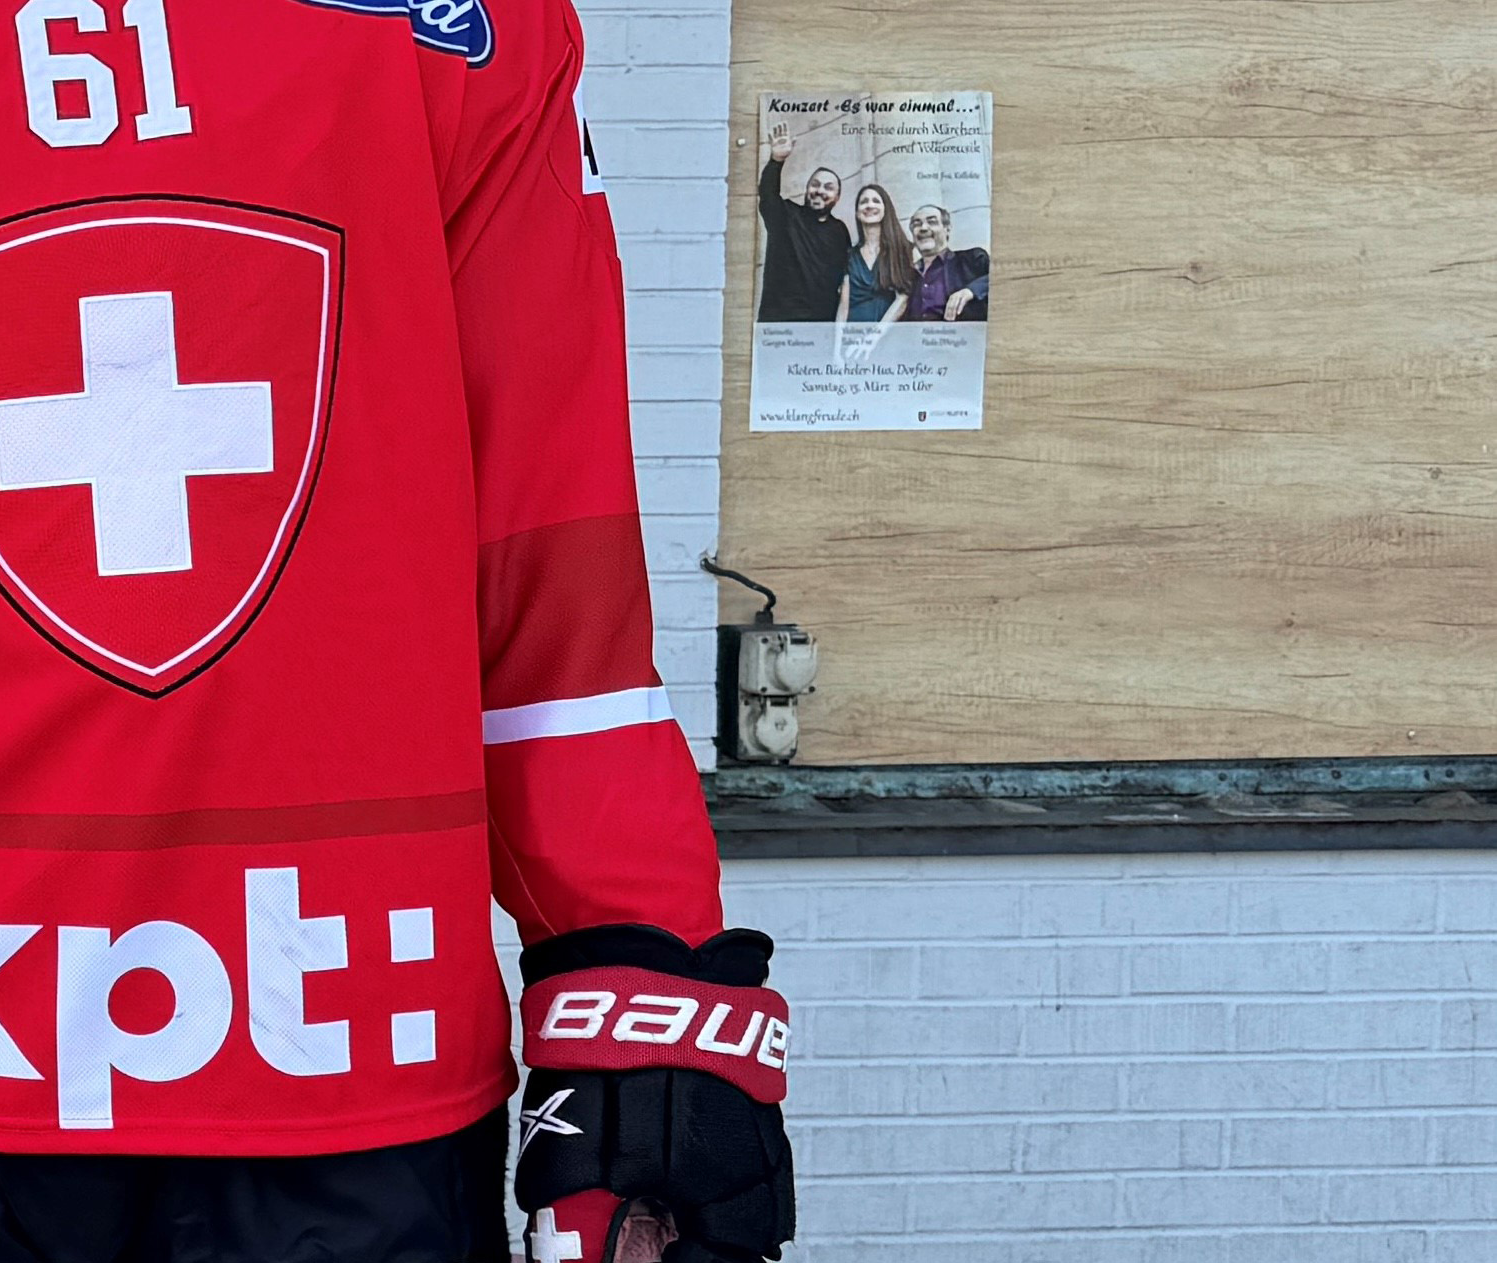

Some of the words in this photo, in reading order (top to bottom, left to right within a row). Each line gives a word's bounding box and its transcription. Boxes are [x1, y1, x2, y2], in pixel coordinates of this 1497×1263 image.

[768, 98, 829, 113] Konzert
[866, 102, 894, 113] war
[897, 121, 929, 135] durch
[538, 991, 792, 1073] BAUE
